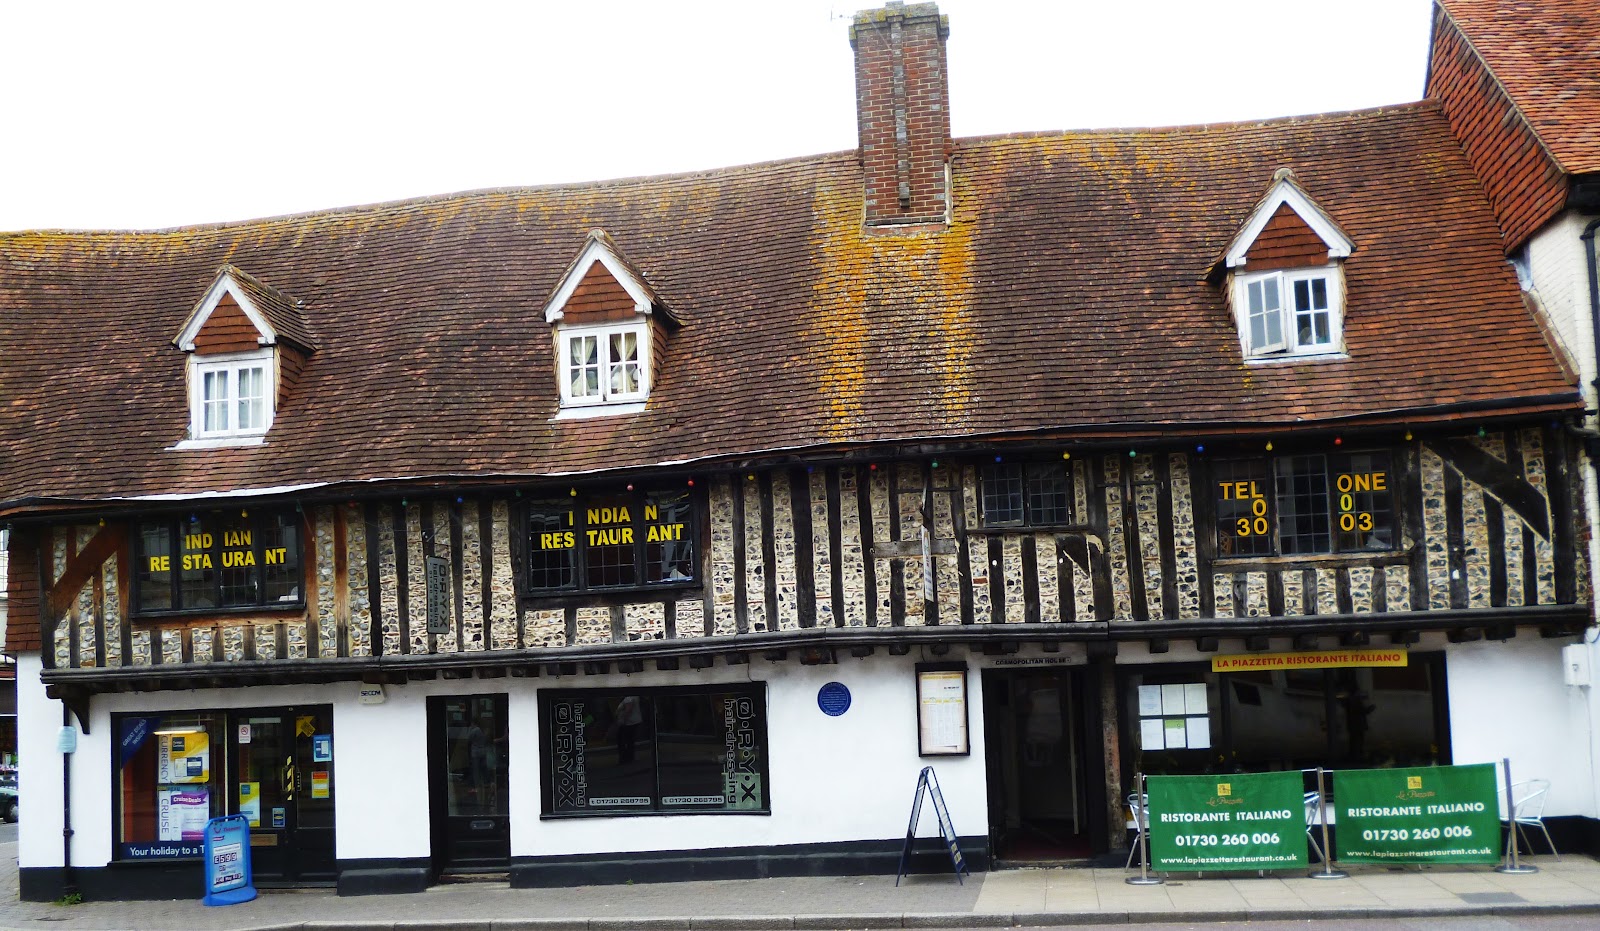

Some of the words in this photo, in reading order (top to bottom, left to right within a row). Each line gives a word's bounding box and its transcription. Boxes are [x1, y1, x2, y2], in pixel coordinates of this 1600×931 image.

[1219, 481, 1264, 499] TEL
[1337, 472, 1387, 493] ONE
[1236, 517, 1268, 537] 30
[1340, 513, 1373, 531] 03
[1217, 660, 1229, 668] LA
[1232, 657, 1284, 667] PIAZZETTA
[1286, 655, 1349, 665] RISTORANTE
[1351, 653, 1401, 663] ITALIANO
[574, 703, 589, 808] hairdressing
[724, 699, 737, 804] hairdressing
[161, 798, 170, 834] CRUISE
[1161, 812, 1230, 823] RISTORANTE
[1236, 810, 1292, 821] ITALIANO
[1348, 806, 1422, 817] RISTORANTE
[1427, 802, 1485, 814] ITALIANO
[1175, 835, 1218, 846] 01730
[1222, 834, 1249, 845] 260
[1252, 833, 1280, 844] 006
[1363, 829, 1408, 841] 01730
[1412, 828, 1440, 840] 260
[1443, 826, 1472, 837] 006
[130, 847, 148, 856] Your
[150, 846, 180, 857] holiday
[181, 847, 191, 855] to
[1346, 847, 1492, 857] www.lapiazzettarestaurant.co.uk
[1160, 854, 1297, 865] www.lapiazzettarestaurant.co.uk
